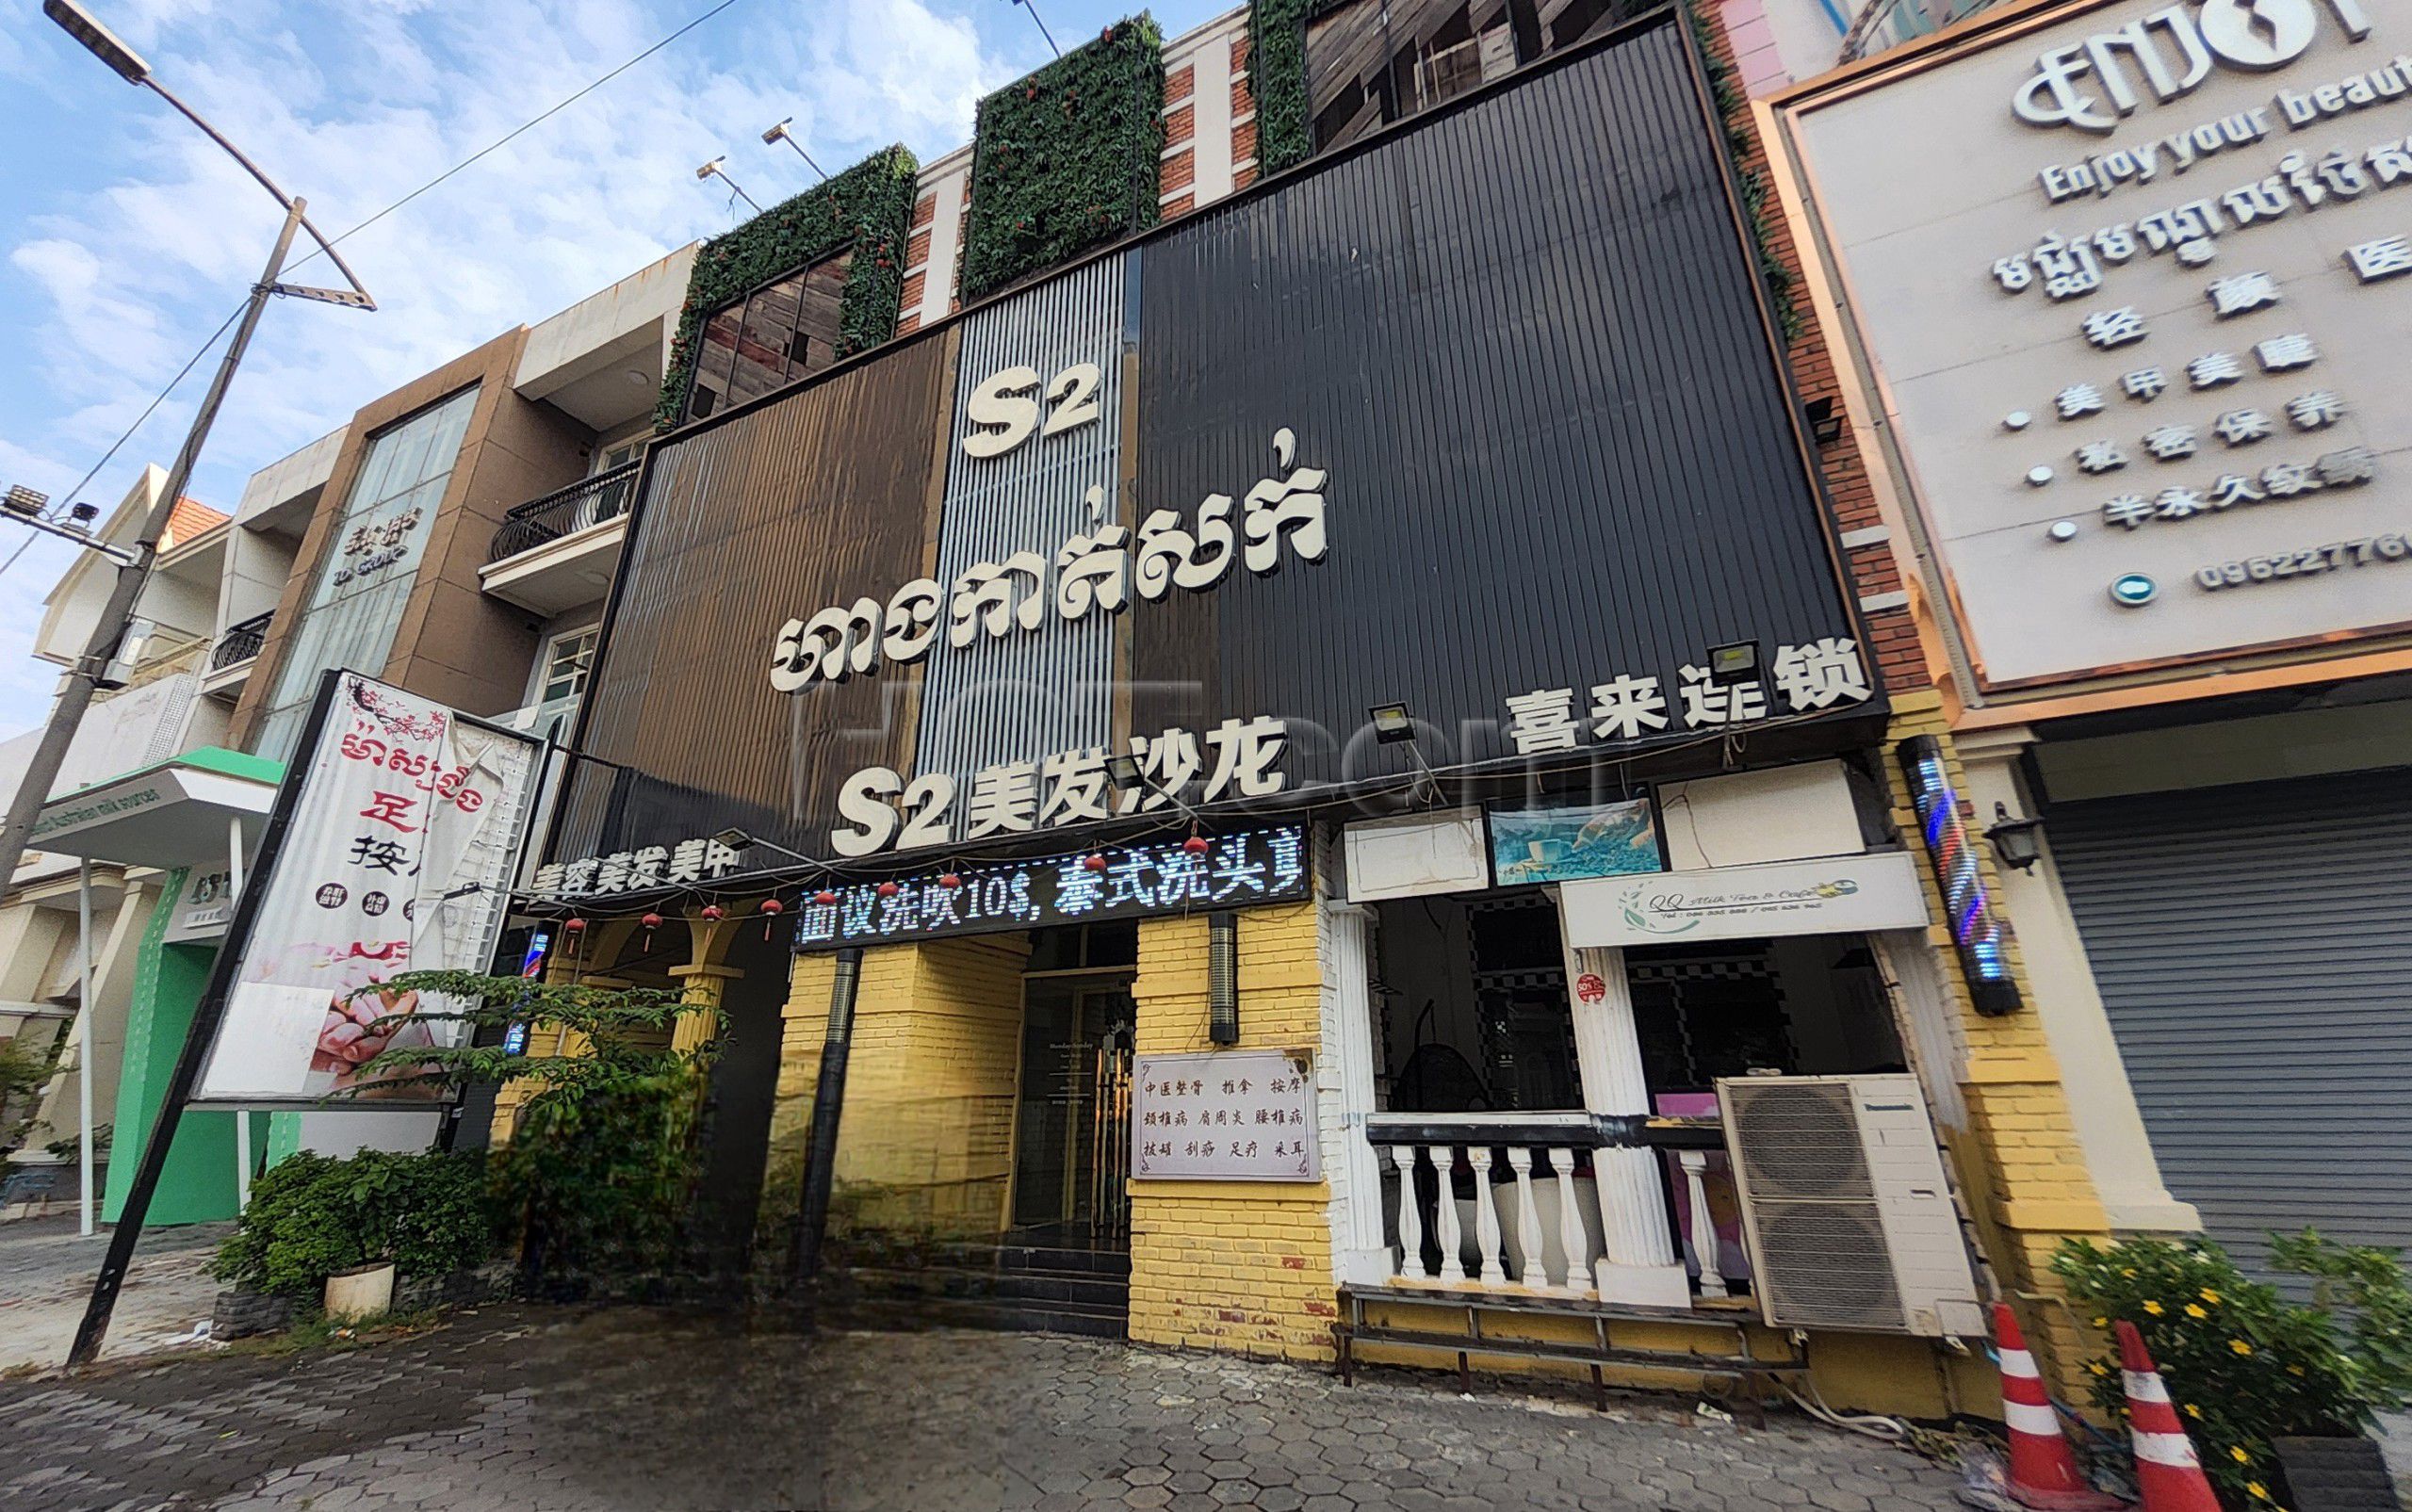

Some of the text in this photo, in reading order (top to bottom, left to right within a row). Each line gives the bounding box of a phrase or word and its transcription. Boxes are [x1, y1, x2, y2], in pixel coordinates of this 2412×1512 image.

[2040, 141, 2157, 202] Enjoy
[2165, 106, 2273, 170] your
[963, 363, 1102, 458] S2
[770, 427, 1328, 692] ហាងកាត់សក់
[2198, 533, 2412, 588] 09622776
[1650, 894, 1684, 911] QQ
[1144, 1077, 1301, 1097] 中医整骨 推拿 按摩
[1144, 1107, 1304, 1128] 颈椎病 肩周炎 腰椎病
[1144, 1141, 1173, 1157] 拔罐
[1184, 1140, 1215, 1158] 刮痧
[1230, 1140, 1258, 1158] 足疗
